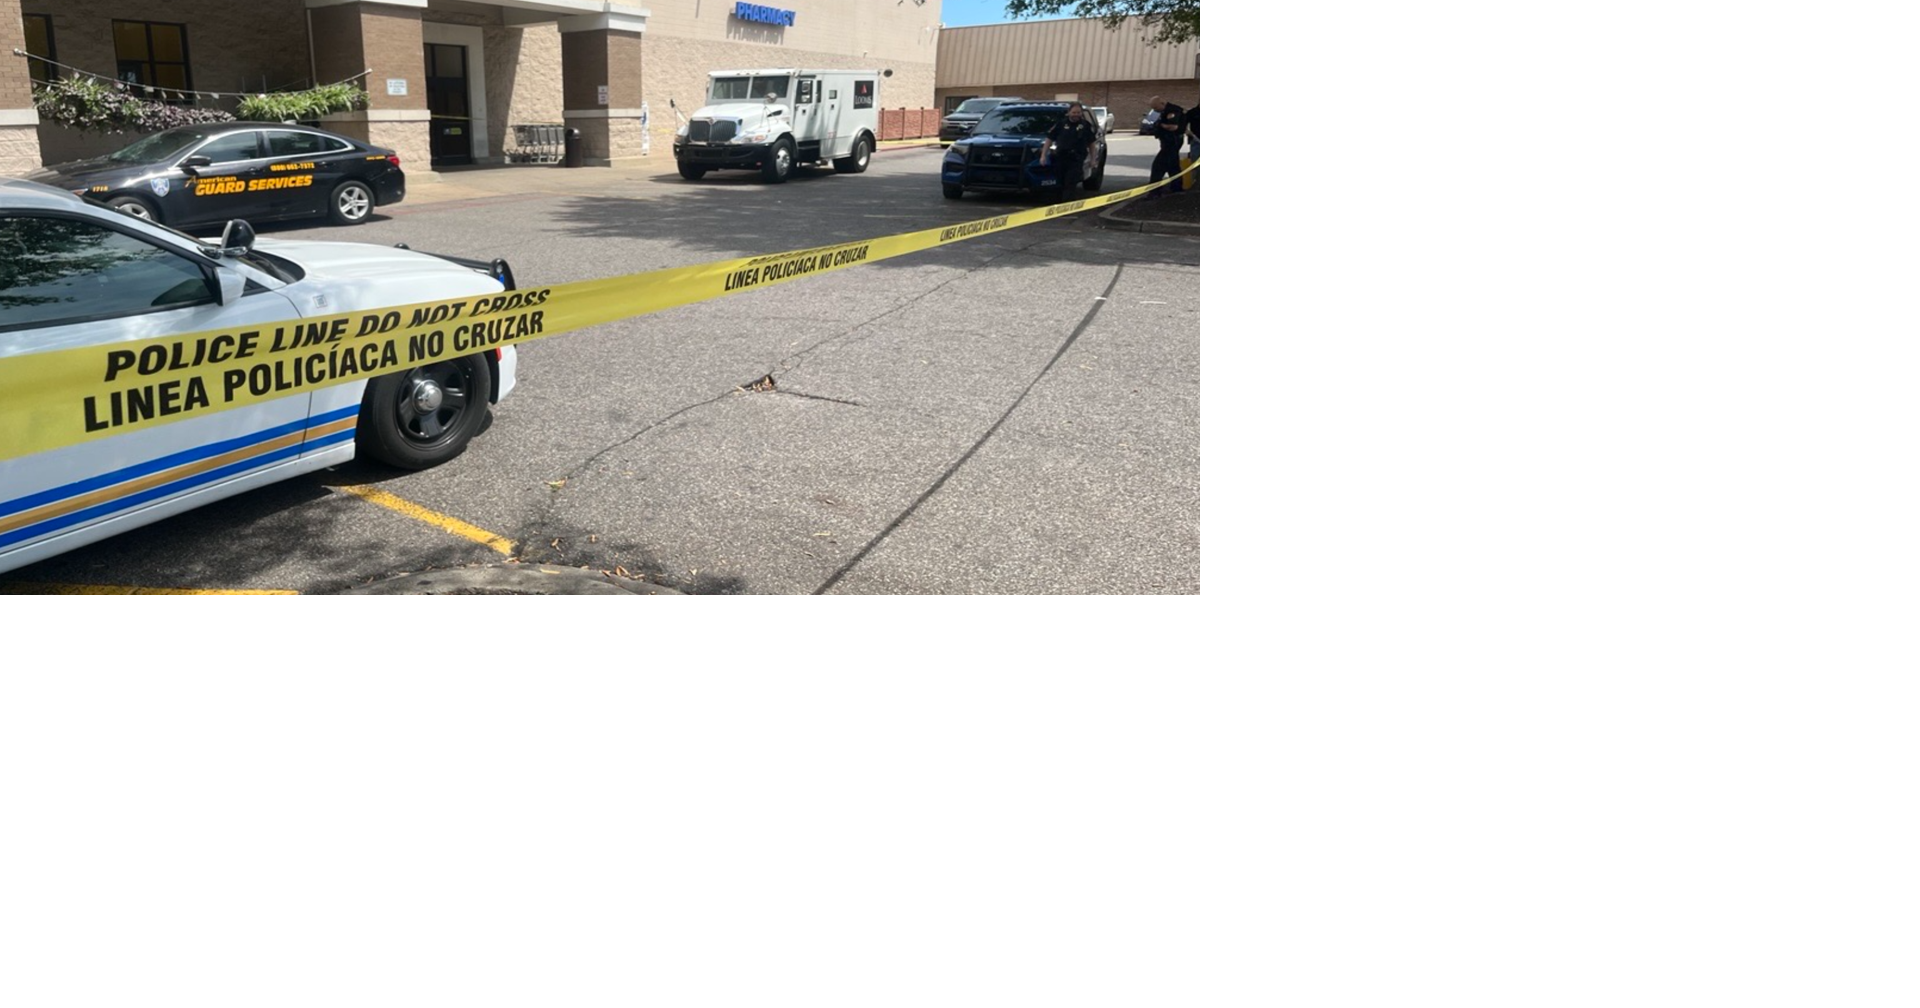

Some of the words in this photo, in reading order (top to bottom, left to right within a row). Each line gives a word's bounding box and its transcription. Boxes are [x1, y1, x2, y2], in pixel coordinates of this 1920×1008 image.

[736, 2, 796, 27] PHARMACY
[185, 176, 237, 188] American
[195, 181, 246, 196] GUARD
[248, 175, 313, 191] SERVICES
[724, 267, 759, 291] LINEA
[818, 252, 832, 270] NO
[833, 245, 869, 266] CRUZAR
[104, 331, 260, 382] POLICE
[269, 318, 348, 354] LINE
[354, 310, 401, 336] DO
[405, 302, 467, 329] NOT
[468, 289, 551, 317] CROSS
[83, 377, 210, 432] LINEA
[408, 332, 444, 362] NO
[452, 310, 544, 352] CRUZAR
